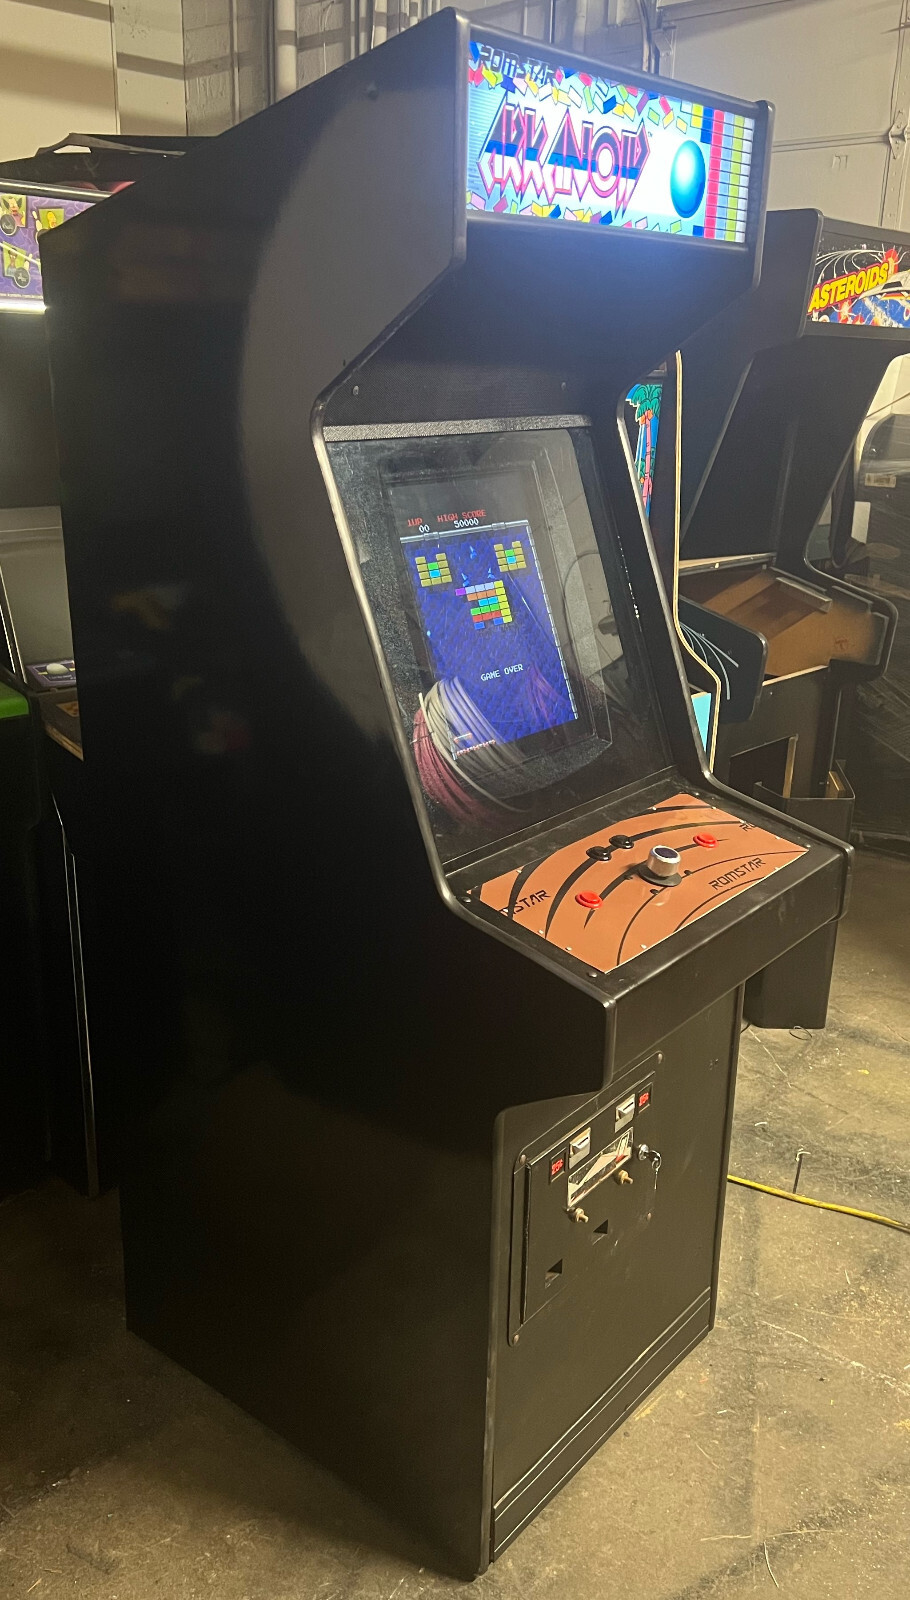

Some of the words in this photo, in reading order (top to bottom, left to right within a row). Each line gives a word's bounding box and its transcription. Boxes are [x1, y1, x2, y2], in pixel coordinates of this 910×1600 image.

[807, 261, 890, 315] ASTEROIDS
[407, 517, 423, 528] 1UP
[437, 512, 458, 523] HIGH
[461, 508, 487, 519] SCORE
[418, 524, 430, 533] 00
[453, 517, 479, 529] 50000
[480, 669, 501, 682] GAME
[503, 663, 524, 675] OVER
[708, 857, 767, 891] ROMSTAR
